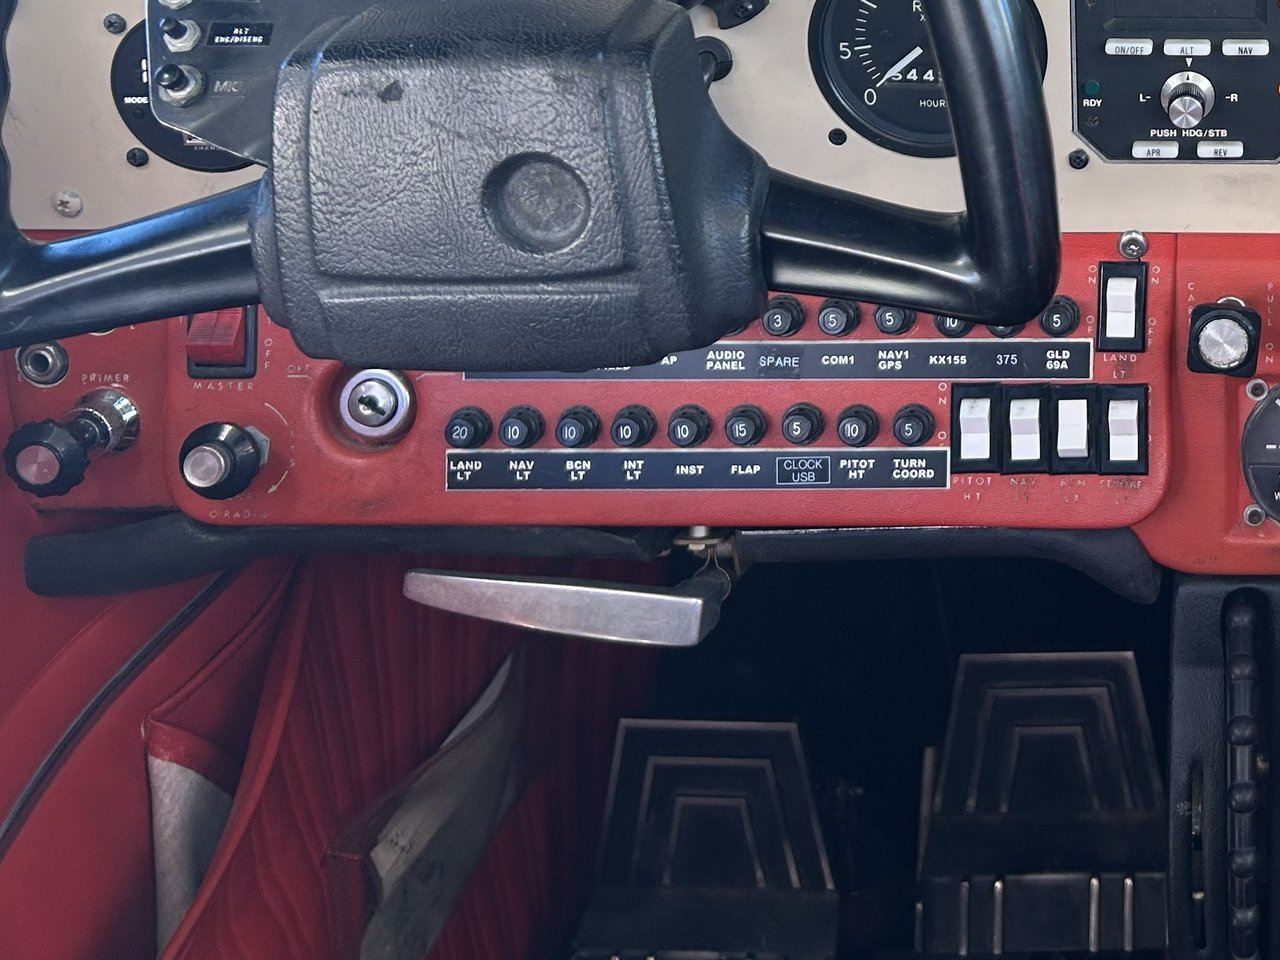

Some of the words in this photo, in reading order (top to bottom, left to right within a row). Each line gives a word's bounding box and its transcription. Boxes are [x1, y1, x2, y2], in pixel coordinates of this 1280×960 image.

[707, 351, 745, 360] AUDIO
[878, 350, 909, 360] NAV1
[1046, 350, 1070, 360] GLD
[822, 355, 854, 365] COM1
[929, 355, 967, 365] KX155
[997, 355, 1018, 365] 375
[706, 361, 745, 370] PANEL
[878, 360, 902, 370] GPS
[1046, 360, 1068, 370] 69A
[450, 461, 482, 470] LAND
[509, 461, 534, 470] NAV
[566, 461, 591, 470] BCN
[624, 461, 644, 470] INT
[784, 459, 822, 470] CLOCK
[840, 459, 875, 469] PITOT
[893, 459, 926, 468] TURN
[676, 465, 704, 474] INST
[731, 465, 761, 474] FLAP
[849, 469, 865, 479] HT
[893, 469, 934, 479] COORD
[457, 471, 471, 480] LT
[516, 471, 530, 480] LT
[571, 471, 585, 480] LT
[626, 471, 640, 480] LT
[792, 471, 815, 482] USB
